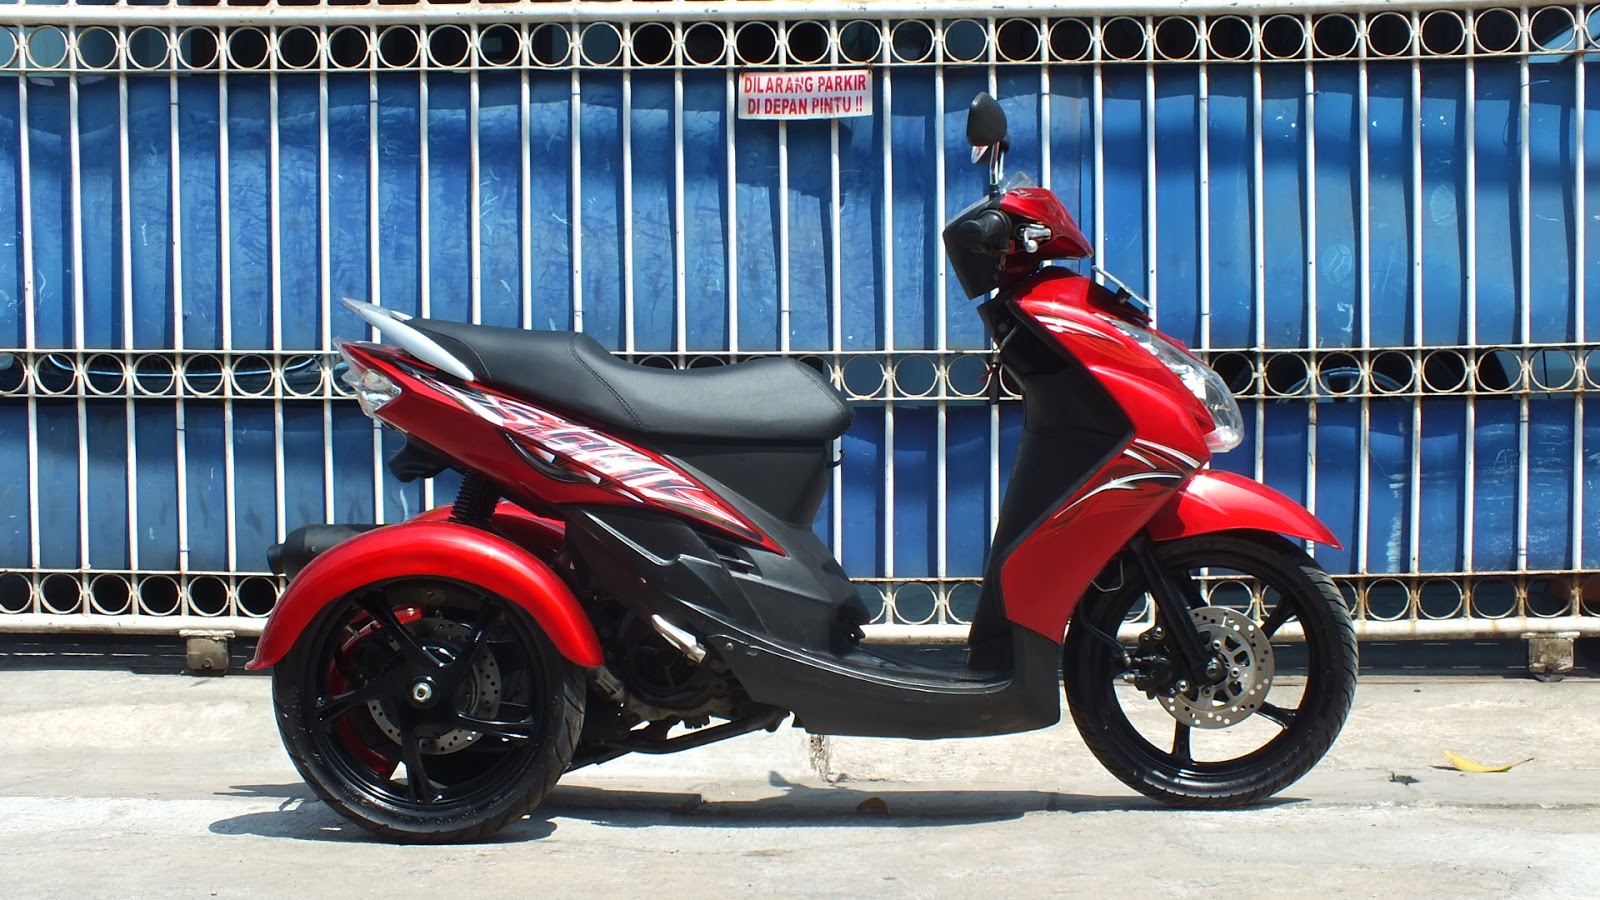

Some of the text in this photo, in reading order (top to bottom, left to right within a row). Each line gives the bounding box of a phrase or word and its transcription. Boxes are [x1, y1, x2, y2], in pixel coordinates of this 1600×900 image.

[744, 74, 867, 94] DILARANG PARKIR
[747, 98, 760, 115] DI
[764, 98, 807, 115] DEPAN
[811, 96, 851, 114] PINTU
